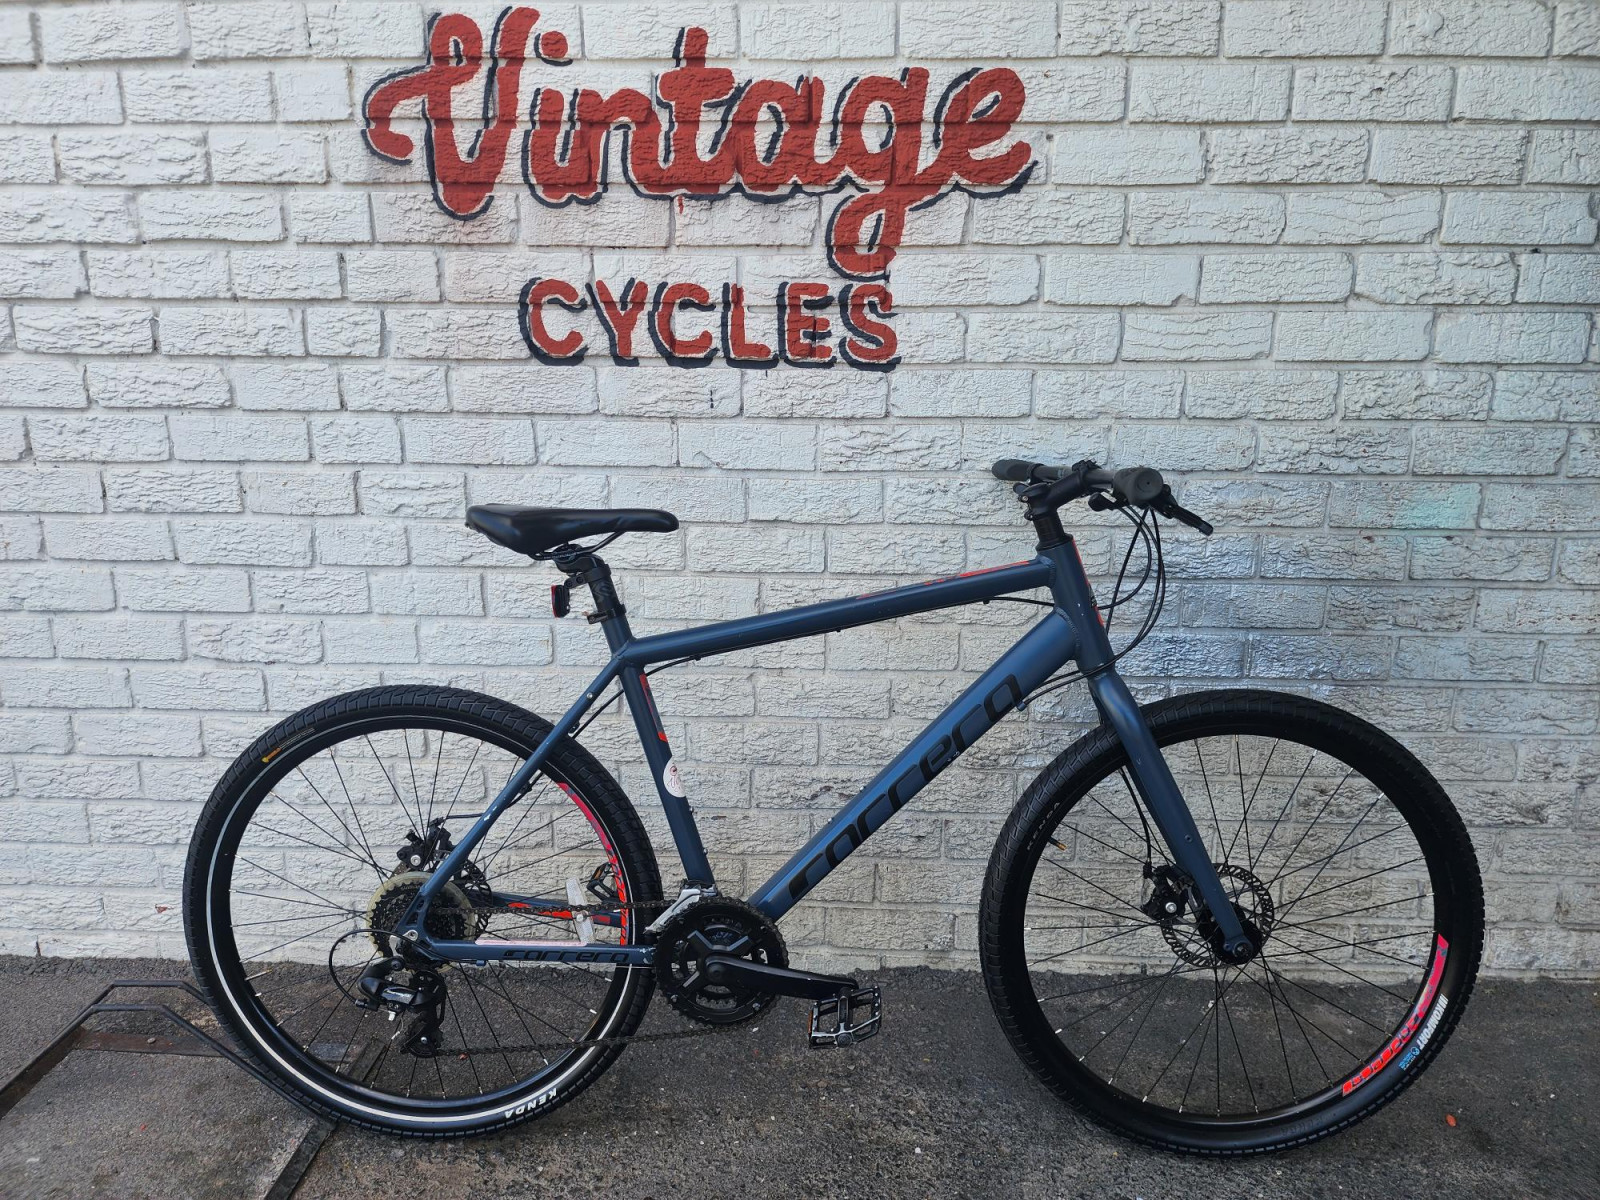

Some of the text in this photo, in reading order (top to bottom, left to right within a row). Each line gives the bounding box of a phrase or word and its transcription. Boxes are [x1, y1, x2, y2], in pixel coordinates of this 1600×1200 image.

[360, 6, 1038, 281] Vintage
[517, 276, 902, 373] CYCLES
[787, 673, 1023, 901] carrera
[502, 949, 631, 962] carrera
[1415, 1002, 1446, 1051] KOMFORT
[504, 1087, 558, 1119] KENDA
